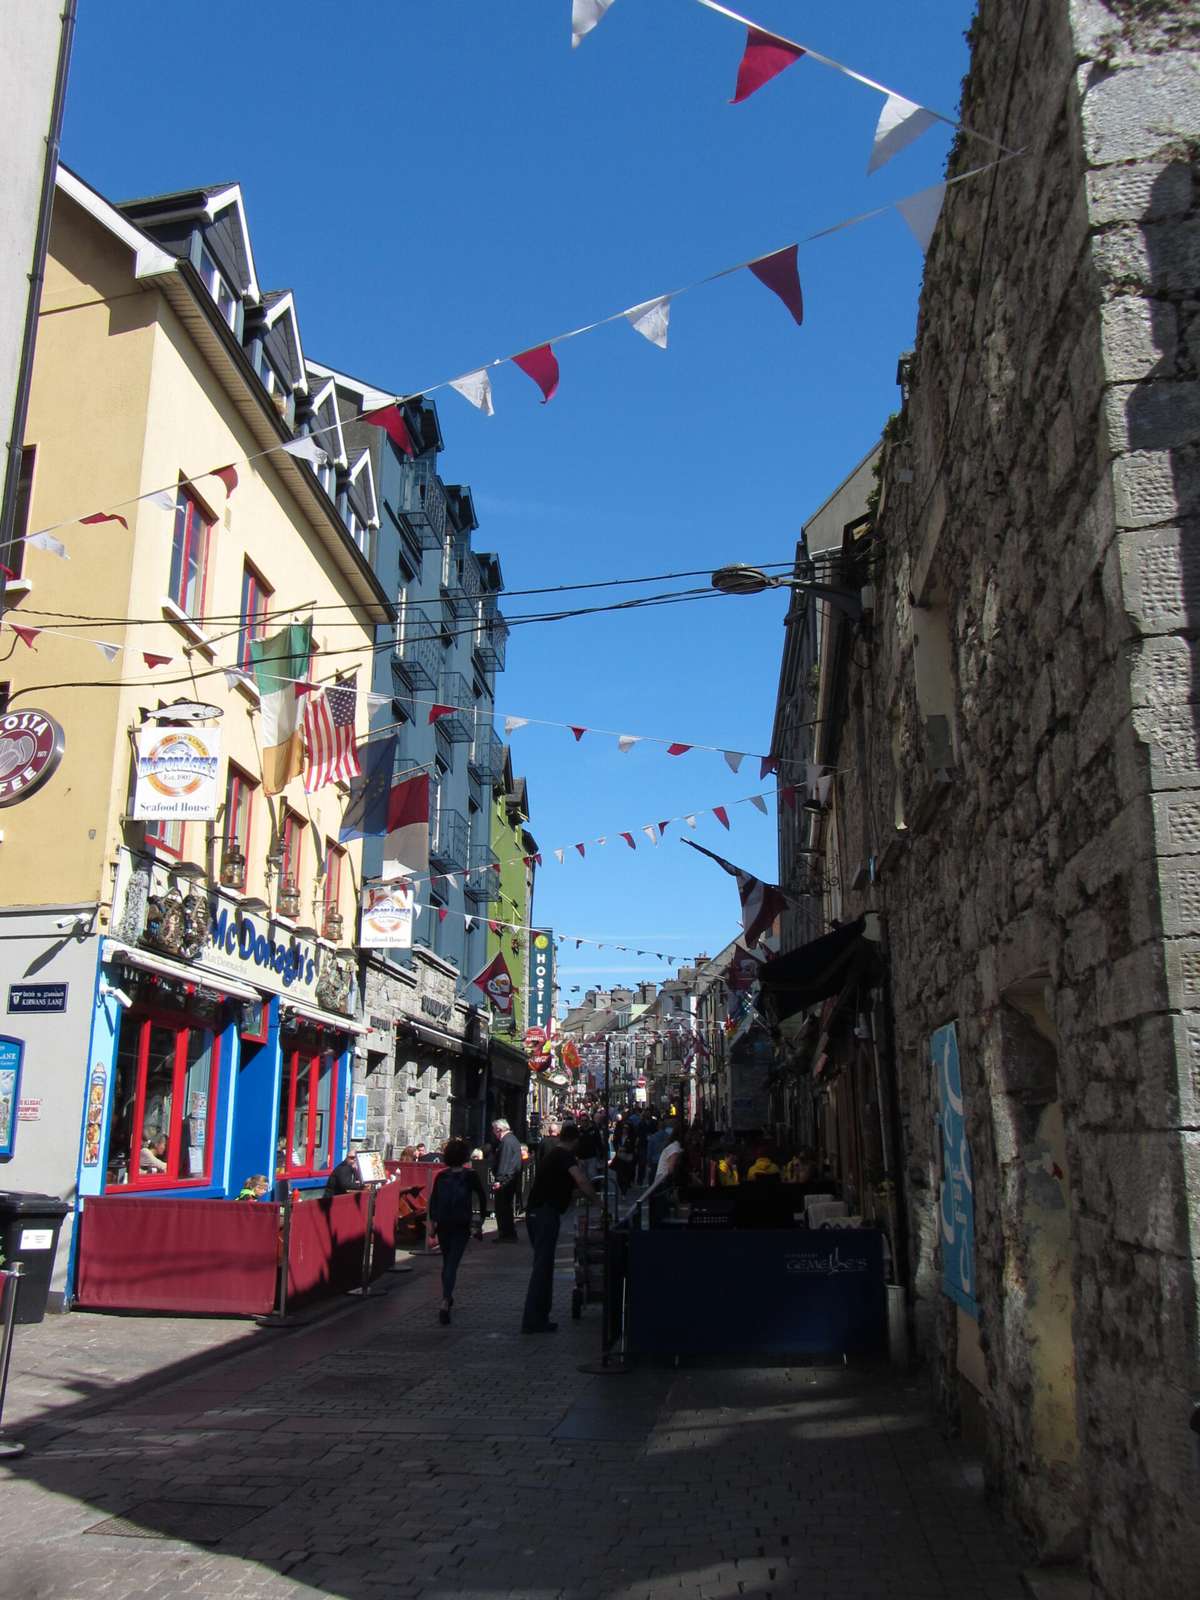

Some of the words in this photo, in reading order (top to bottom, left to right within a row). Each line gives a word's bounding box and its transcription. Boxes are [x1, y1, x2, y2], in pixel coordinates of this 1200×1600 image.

[0, 714, 48, 736] OSTA
[140, 802, 178, 811] Seafood
[180, 803, 210, 811] House
[208, 908, 314, 987] McDonagh's
[535, 953, 546, 1028] HOSTEL
[47, 998, 63, 1006] LANE
[0, 1052, 16, 1060] ANE
